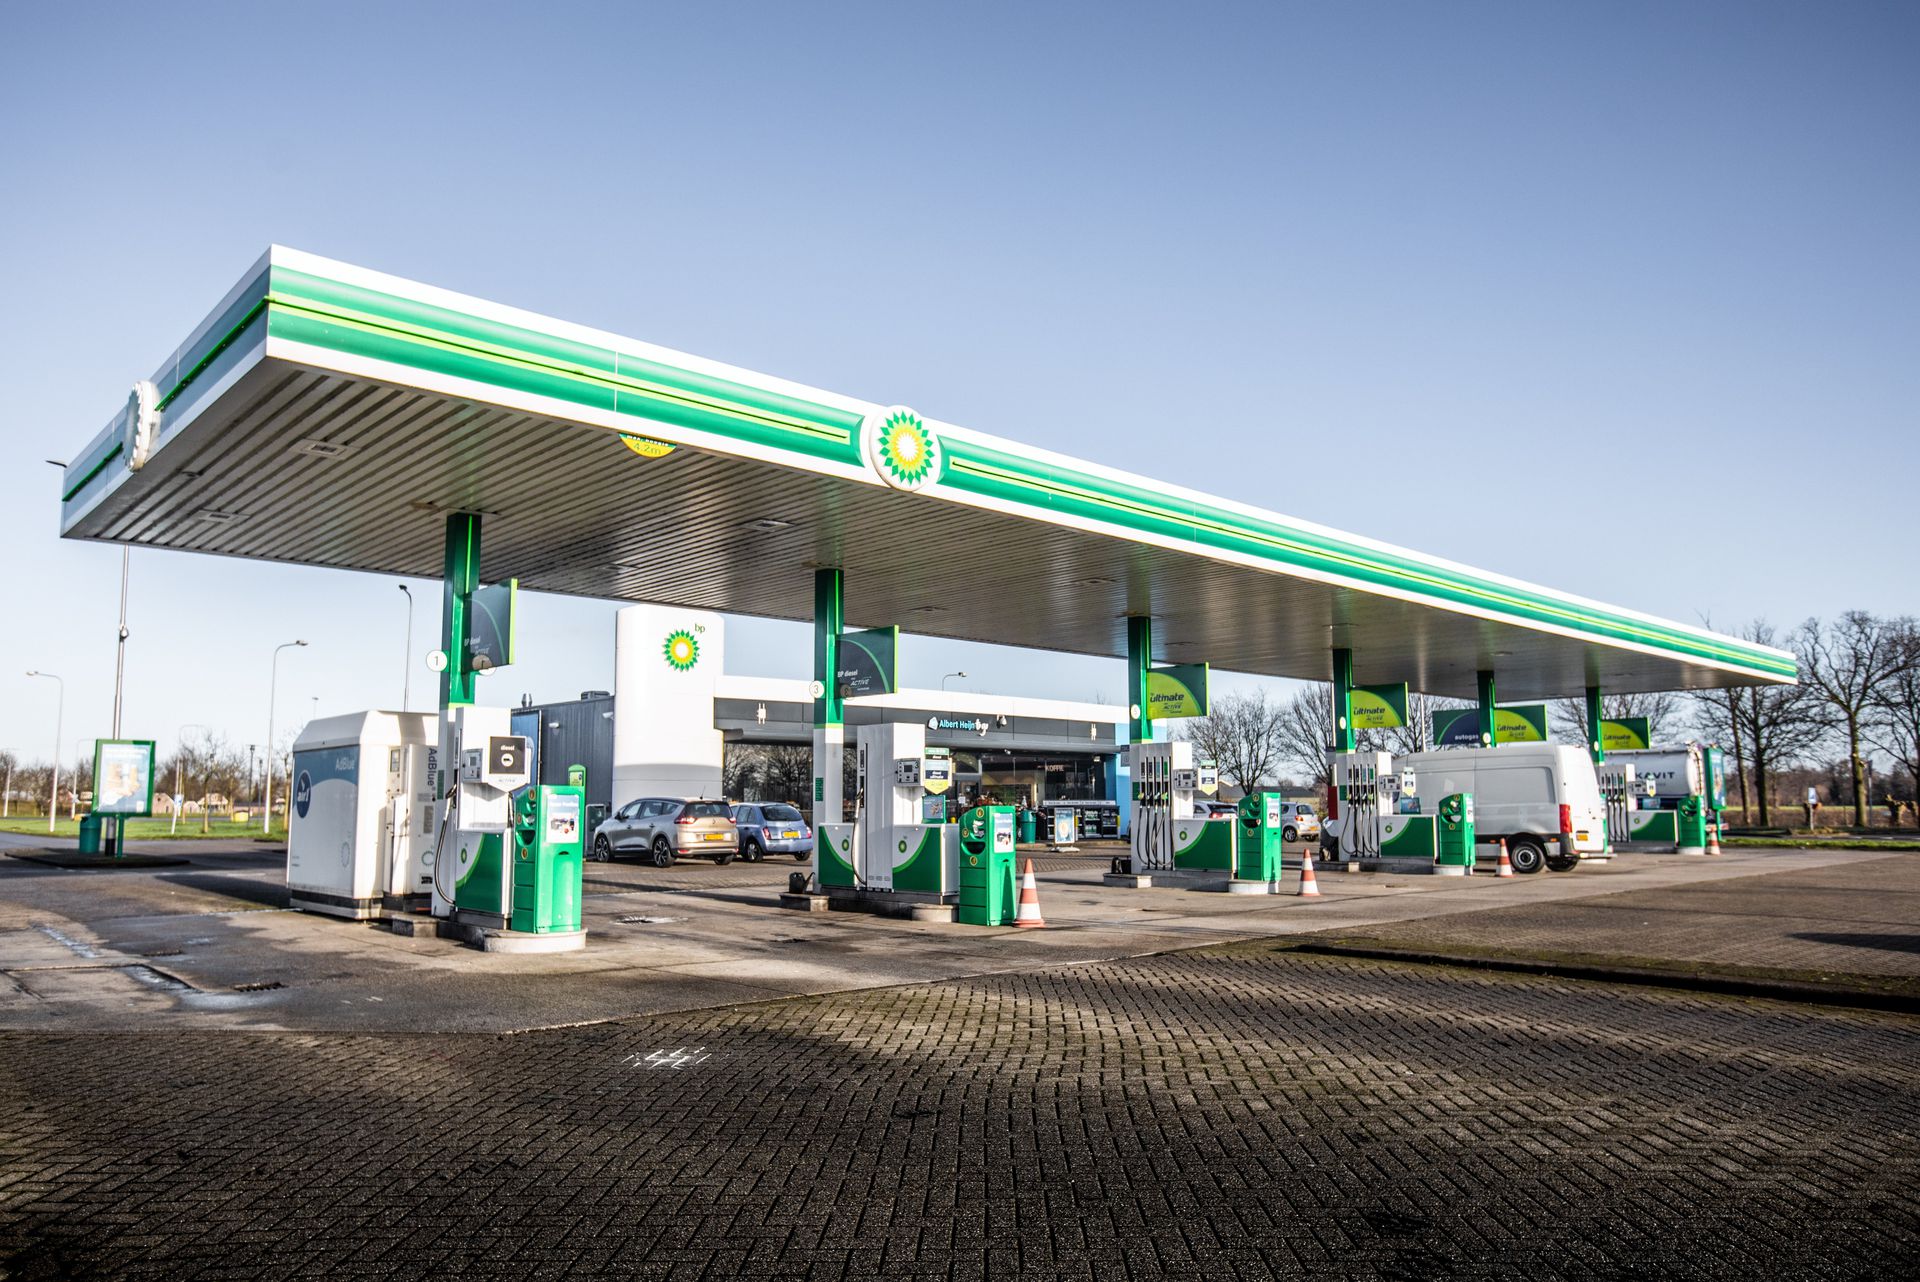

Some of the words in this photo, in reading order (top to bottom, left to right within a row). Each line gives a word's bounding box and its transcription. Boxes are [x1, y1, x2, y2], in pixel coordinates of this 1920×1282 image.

[694, 623, 706, 634] bp
[939, 719, 959, 728] Albert
[960, 721, 976, 731] Heijn
[1045, 764, 1065, 772] KOFFIE
